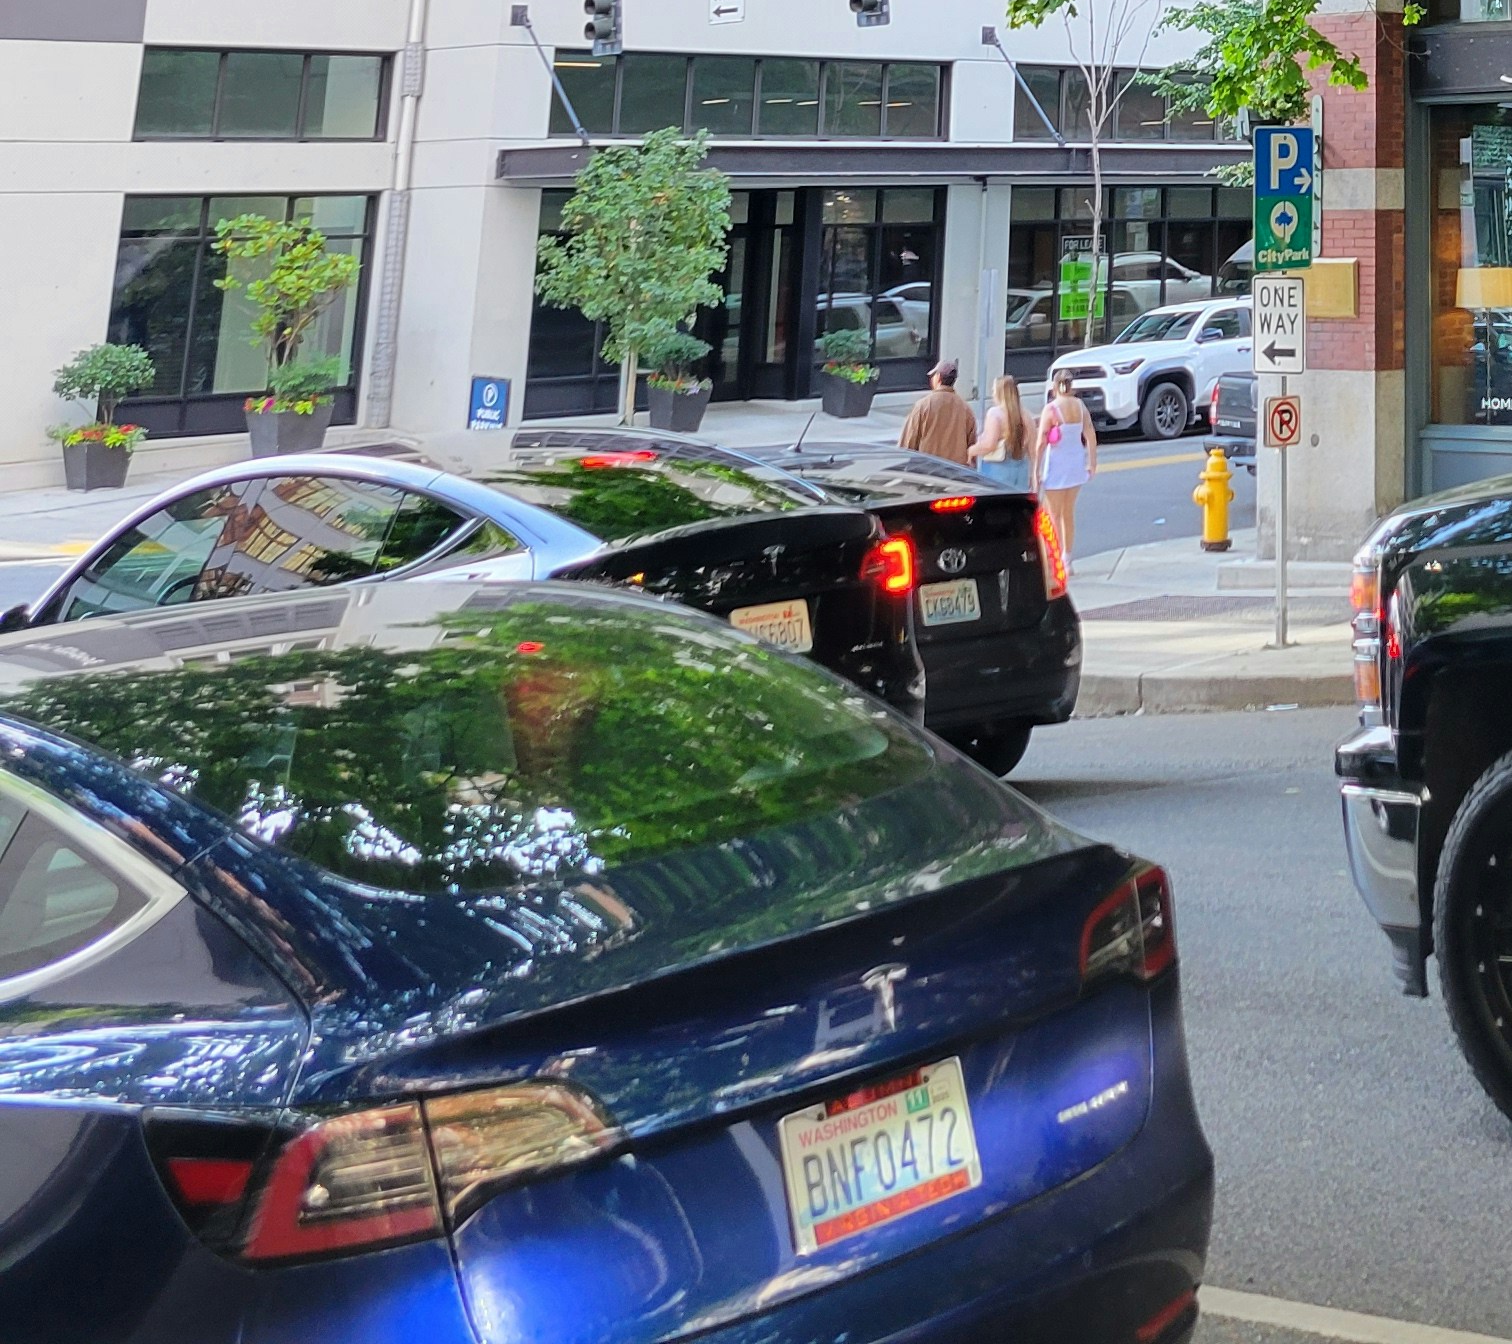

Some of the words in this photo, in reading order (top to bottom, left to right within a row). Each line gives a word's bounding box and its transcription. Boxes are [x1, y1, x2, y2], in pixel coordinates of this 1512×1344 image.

[1270, 133, 1298, 190] P
[1064, 239, 1078, 250] FOR
[1080, 239, 1103, 250] LEAE
[1258, 247, 1310, 265] CityPark
[1260, 286, 1298, 308] ONE
[1259, 313, 1299, 335] WAY
[798, 1100, 898, 1149] WASHINGTON
[802, 1107, 965, 1219] BNF0472
